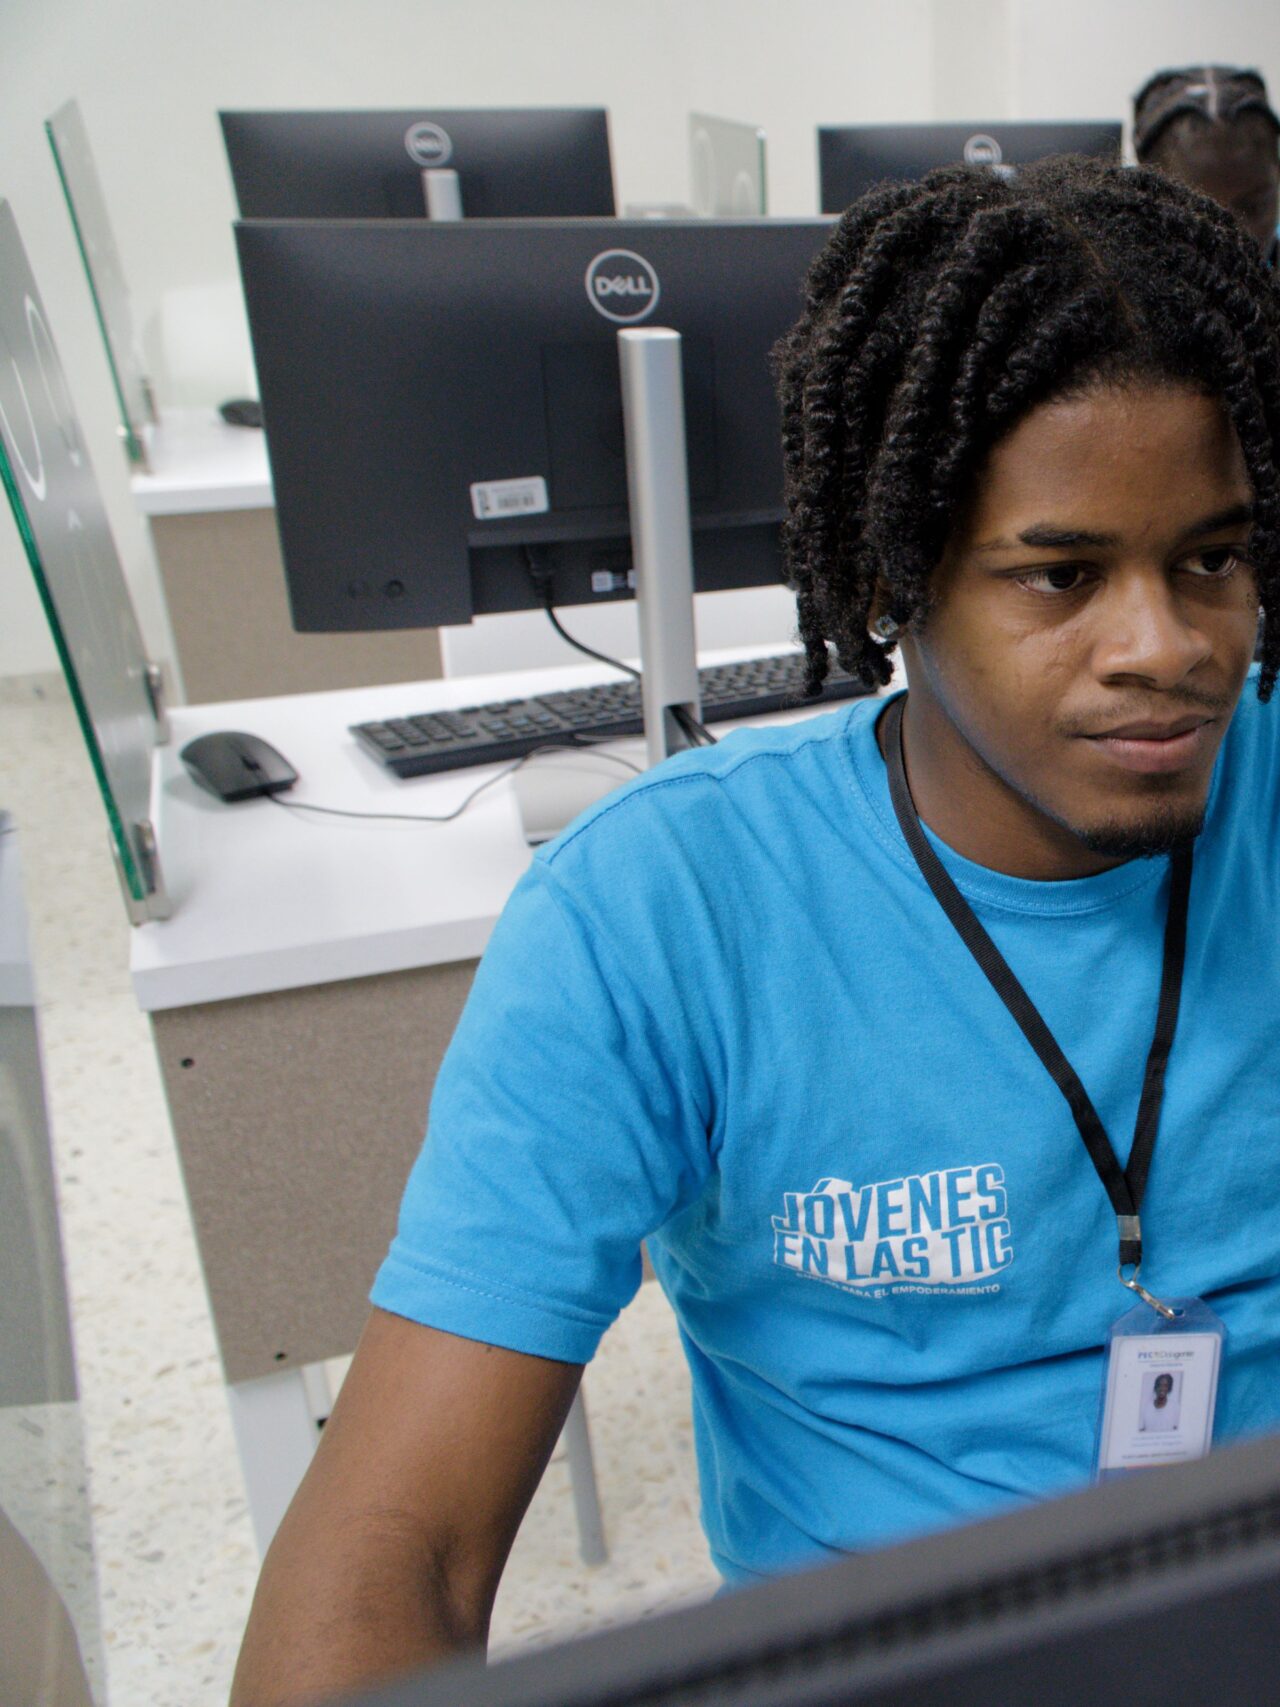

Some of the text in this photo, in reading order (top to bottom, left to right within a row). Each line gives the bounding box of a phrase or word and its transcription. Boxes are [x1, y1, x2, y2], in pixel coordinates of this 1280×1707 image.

[595, 275, 652, 296] DELL
[772, 1163, 1007, 1242] JÓVENES
[775, 1220, 1011, 1281] EN LAS TIC
[873, 1288, 889, 1299] EL
[891, 1283, 1001, 1295] EMPODERAMIENTO
